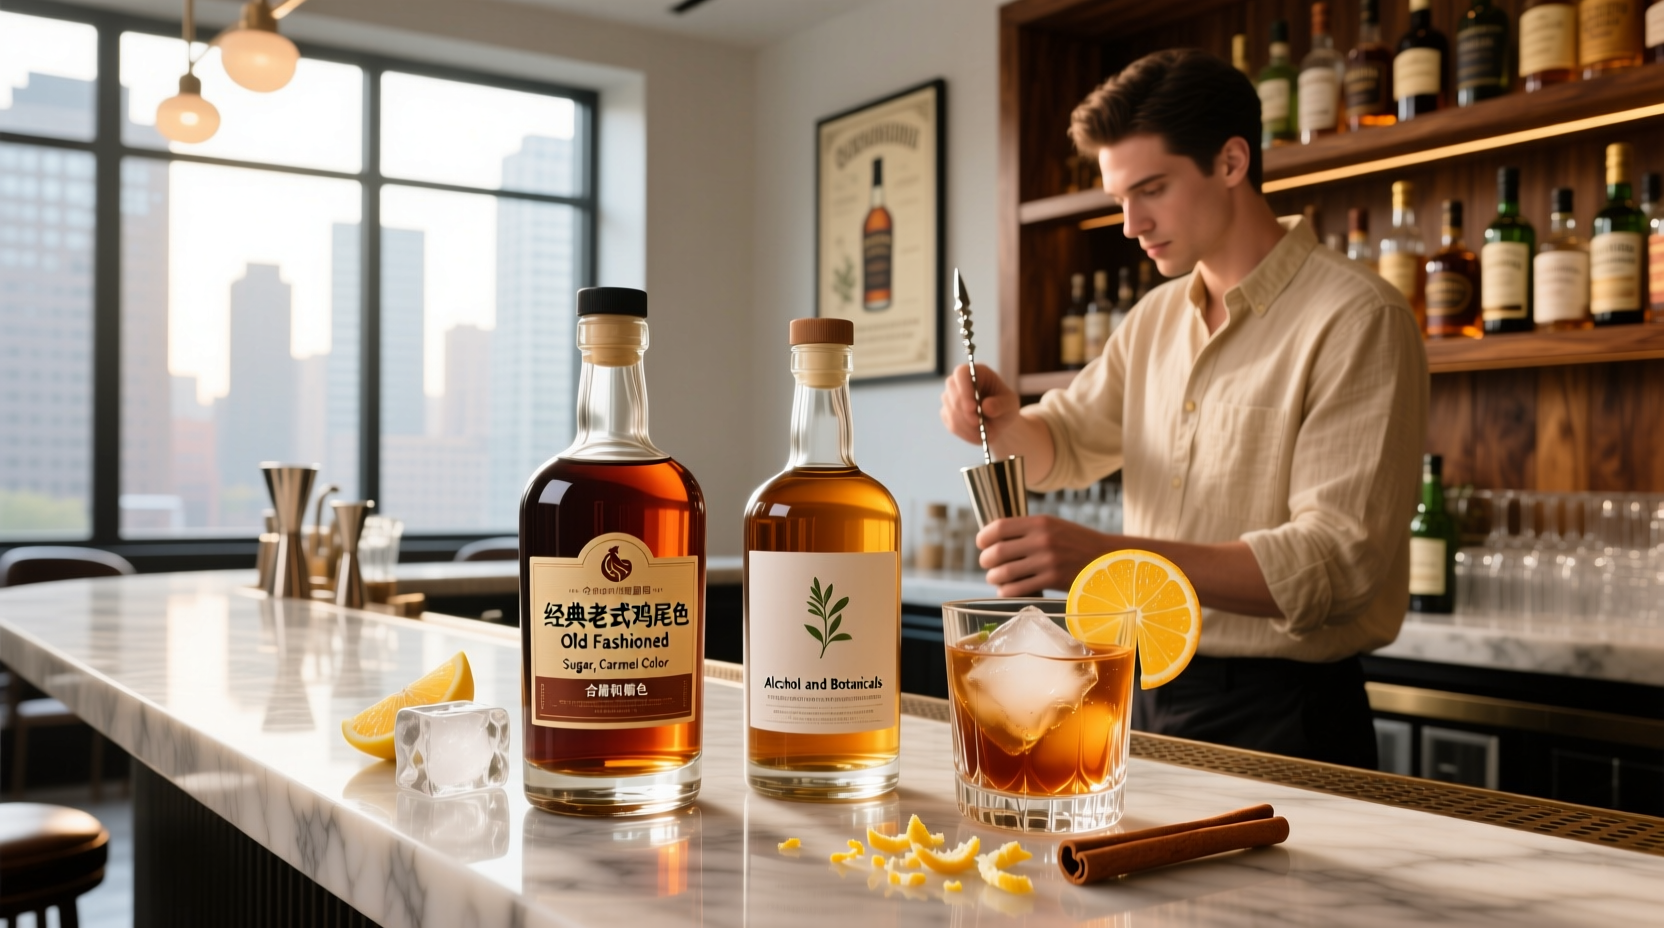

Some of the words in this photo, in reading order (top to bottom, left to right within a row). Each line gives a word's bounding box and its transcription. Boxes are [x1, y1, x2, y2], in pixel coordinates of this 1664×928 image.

[544, 602, 690, 629] 经典老式鸡尾色
[561, 632, 588, 650] Old
[593, 631, 670, 650] Fashioned
[562, 658, 597, 674] Sugar,
[599, 658, 639, 670] Carmel
[641, 656, 669, 669] Color
[764, 676, 801, 690] Alcohol
[805, 678, 827, 690] and
[830, 676, 883, 690] Botanicals
